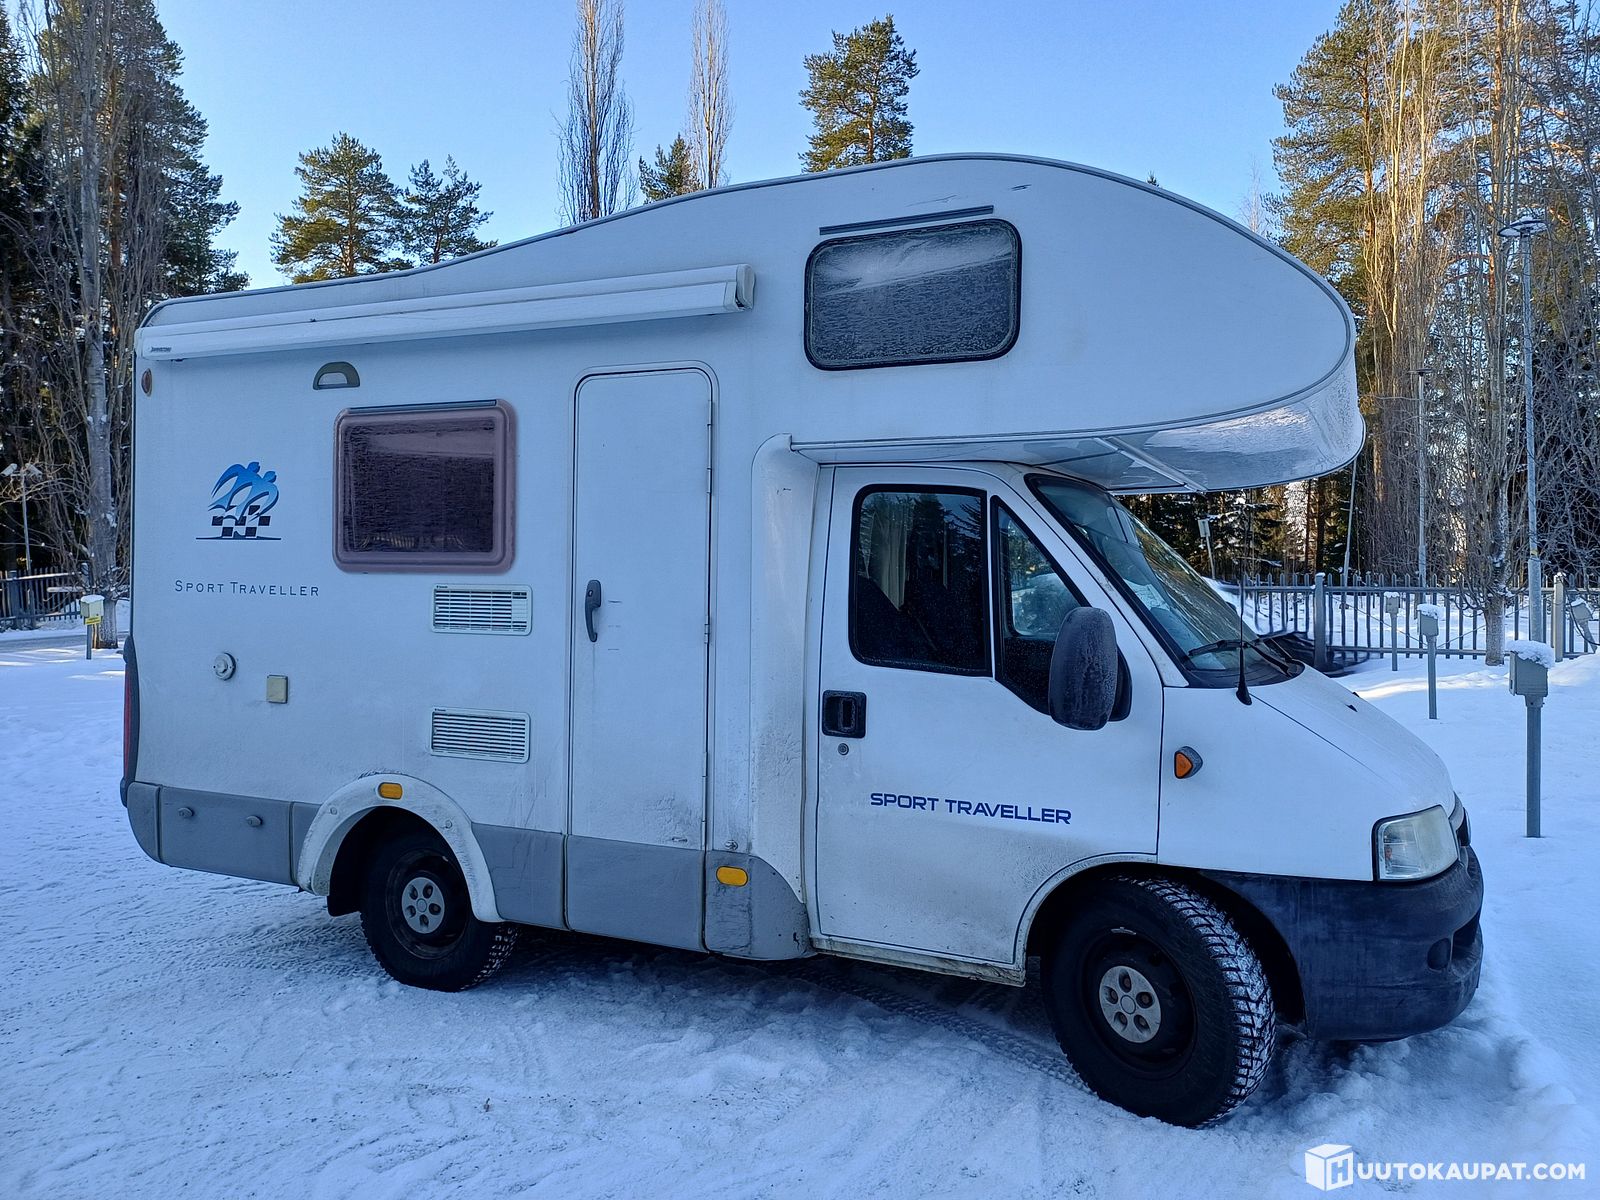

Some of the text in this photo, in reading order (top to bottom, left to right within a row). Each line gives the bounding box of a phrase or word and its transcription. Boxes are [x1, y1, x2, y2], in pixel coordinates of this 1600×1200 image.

[175, 580, 319, 596] SPORT TRAVELLER
[870, 792, 1072, 825] SPORT TRAVELLER
